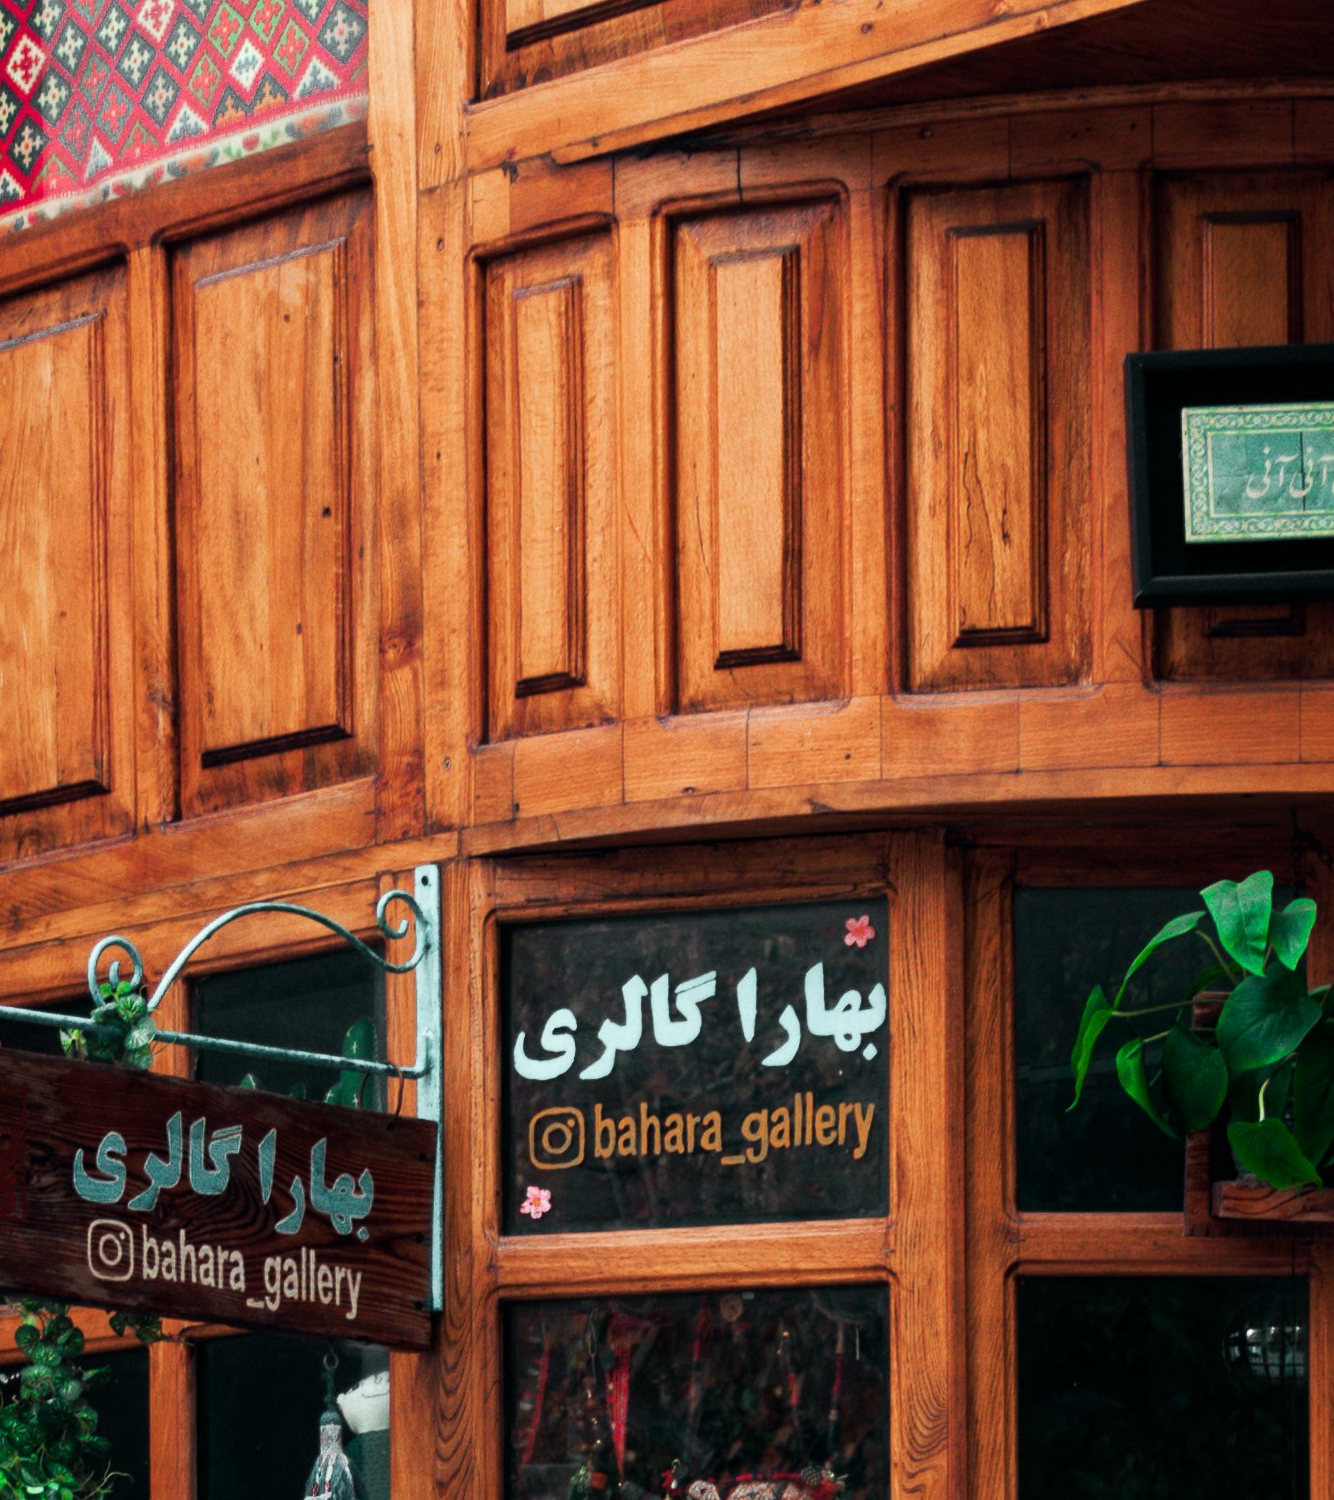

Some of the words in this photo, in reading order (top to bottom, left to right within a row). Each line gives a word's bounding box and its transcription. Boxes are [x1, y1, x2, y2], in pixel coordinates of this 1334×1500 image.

[513, 969, 717, 1081] گالری
[736, 961, 887, 1067] بهارا
[72, 1110, 244, 1212] گالری
[594, 1091, 876, 1166] bahara_gallery
[257, 1127, 375, 1243] بهارا
[141, 1222, 363, 1320] bahara_gallery
